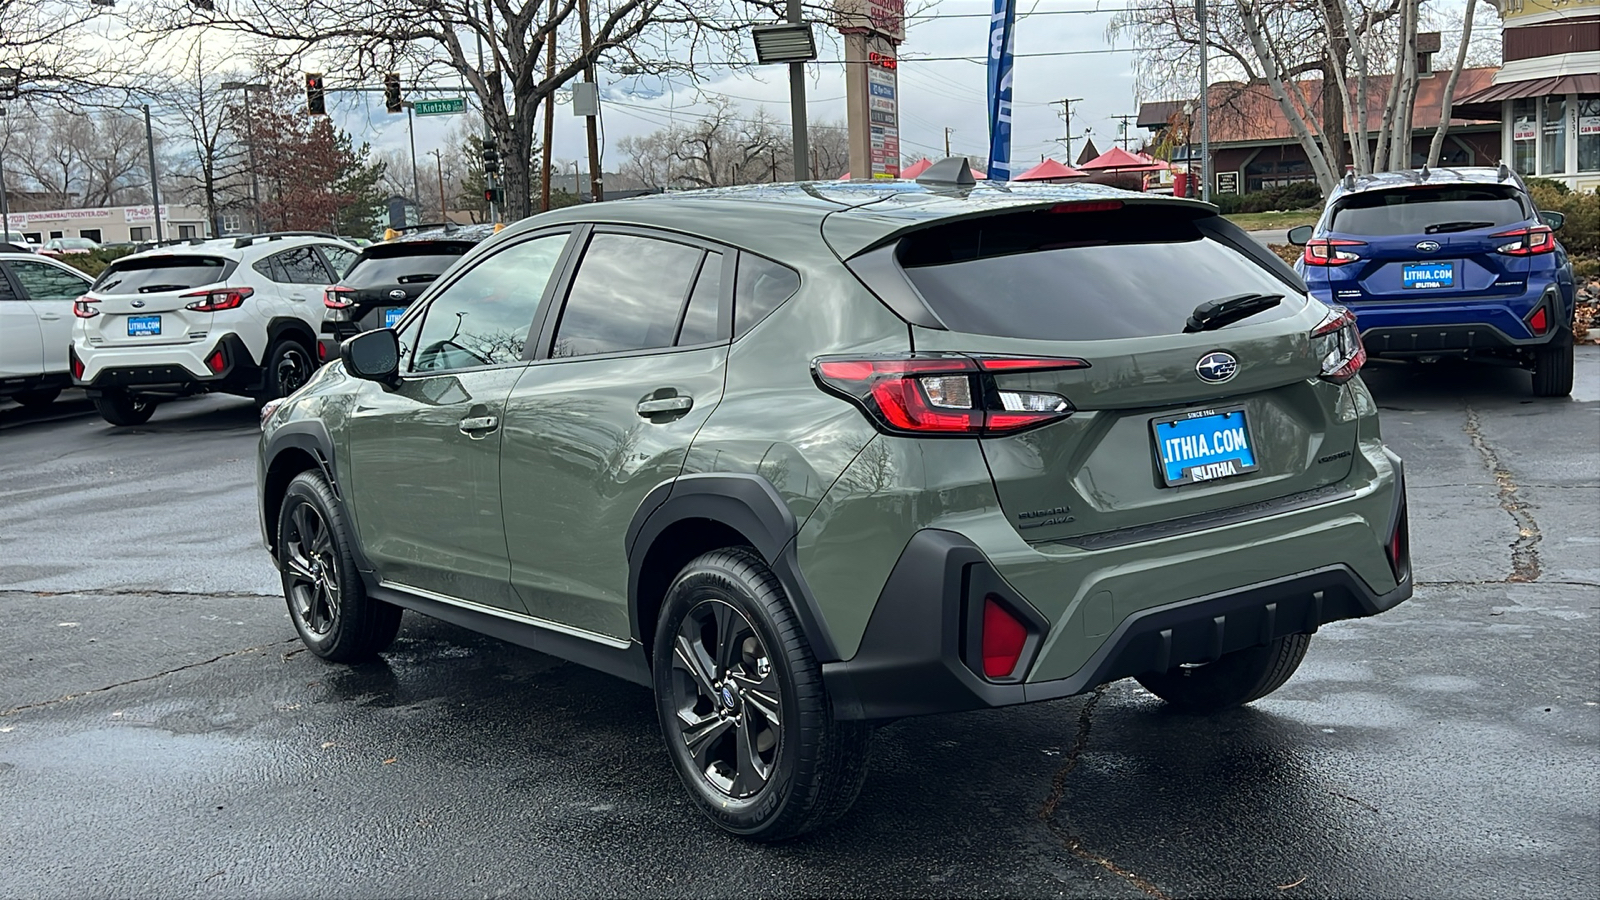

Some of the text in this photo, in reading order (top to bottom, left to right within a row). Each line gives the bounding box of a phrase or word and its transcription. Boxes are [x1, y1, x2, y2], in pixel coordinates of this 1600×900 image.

[422, 103, 451, 112] Kietzke
[1404, 270, 1452, 281] LITHIA.COM
[129, 322, 160, 330] LITHIA.COM
[1187, 410, 1202, 419] SINCE
[1164, 427, 1248, 464] ITHIA.COM
[1202, 461, 1237, 480] LITHIA
[1018, 506, 1071, 520] SUBARU
